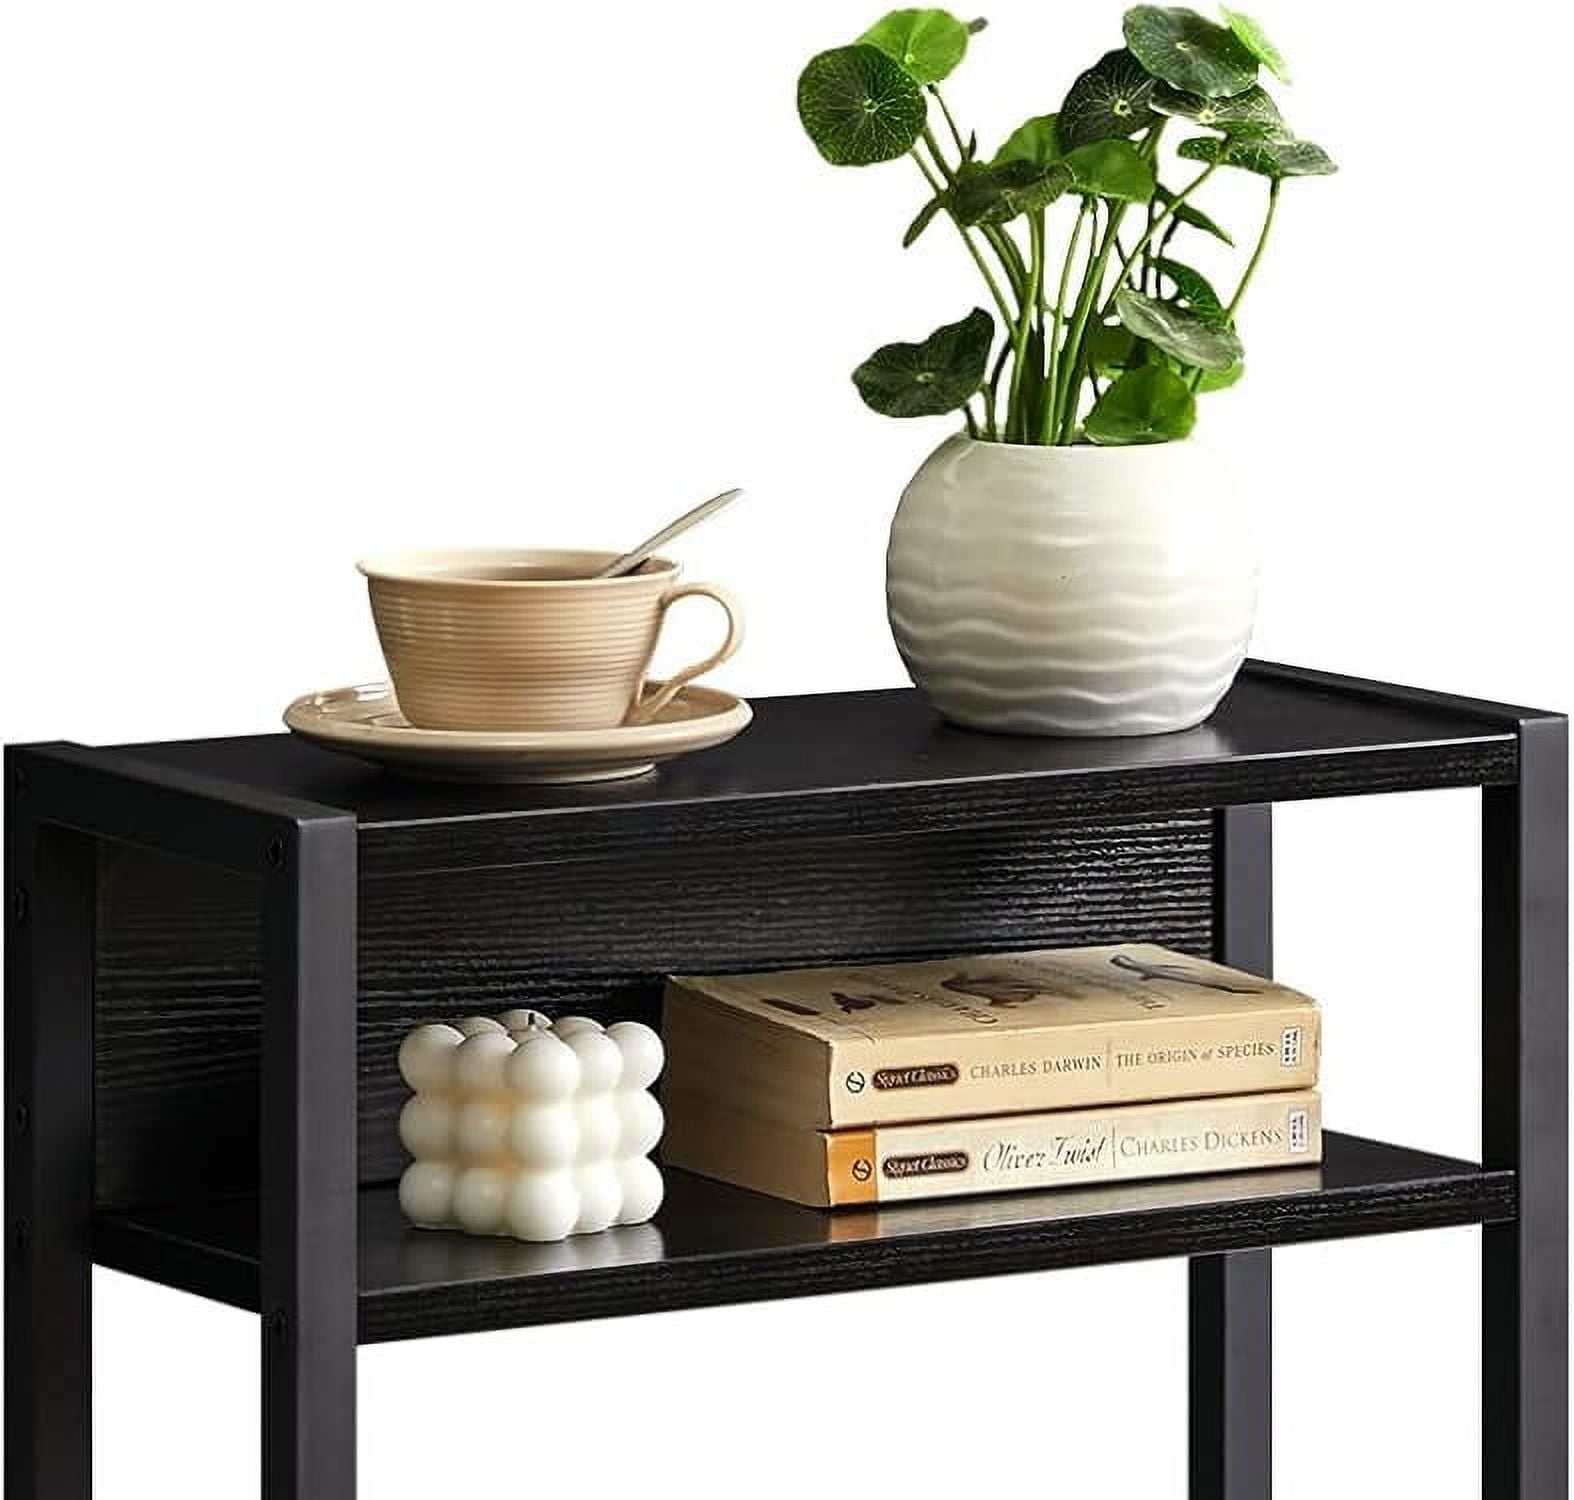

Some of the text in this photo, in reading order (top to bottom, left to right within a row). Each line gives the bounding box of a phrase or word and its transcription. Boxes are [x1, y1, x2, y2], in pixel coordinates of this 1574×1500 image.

[970, 1060, 1037, 1079] CHARLES
[1042, 1055, 1103, 1074] DARWIN
[1116, 1053, 1144, 1068] THE
[1147, 1048, 1199, 1065] ORIGIN
[1216, 1042, 1277, 1059] SPECIES
[983, 1142, 1047, 1171] Oliver
[1054, 1136, 1107, 1166] Twist
[1119, 1135, 1200, 1158] CHARLES
[1204, 1129, 1283, 1152] DICKENS
